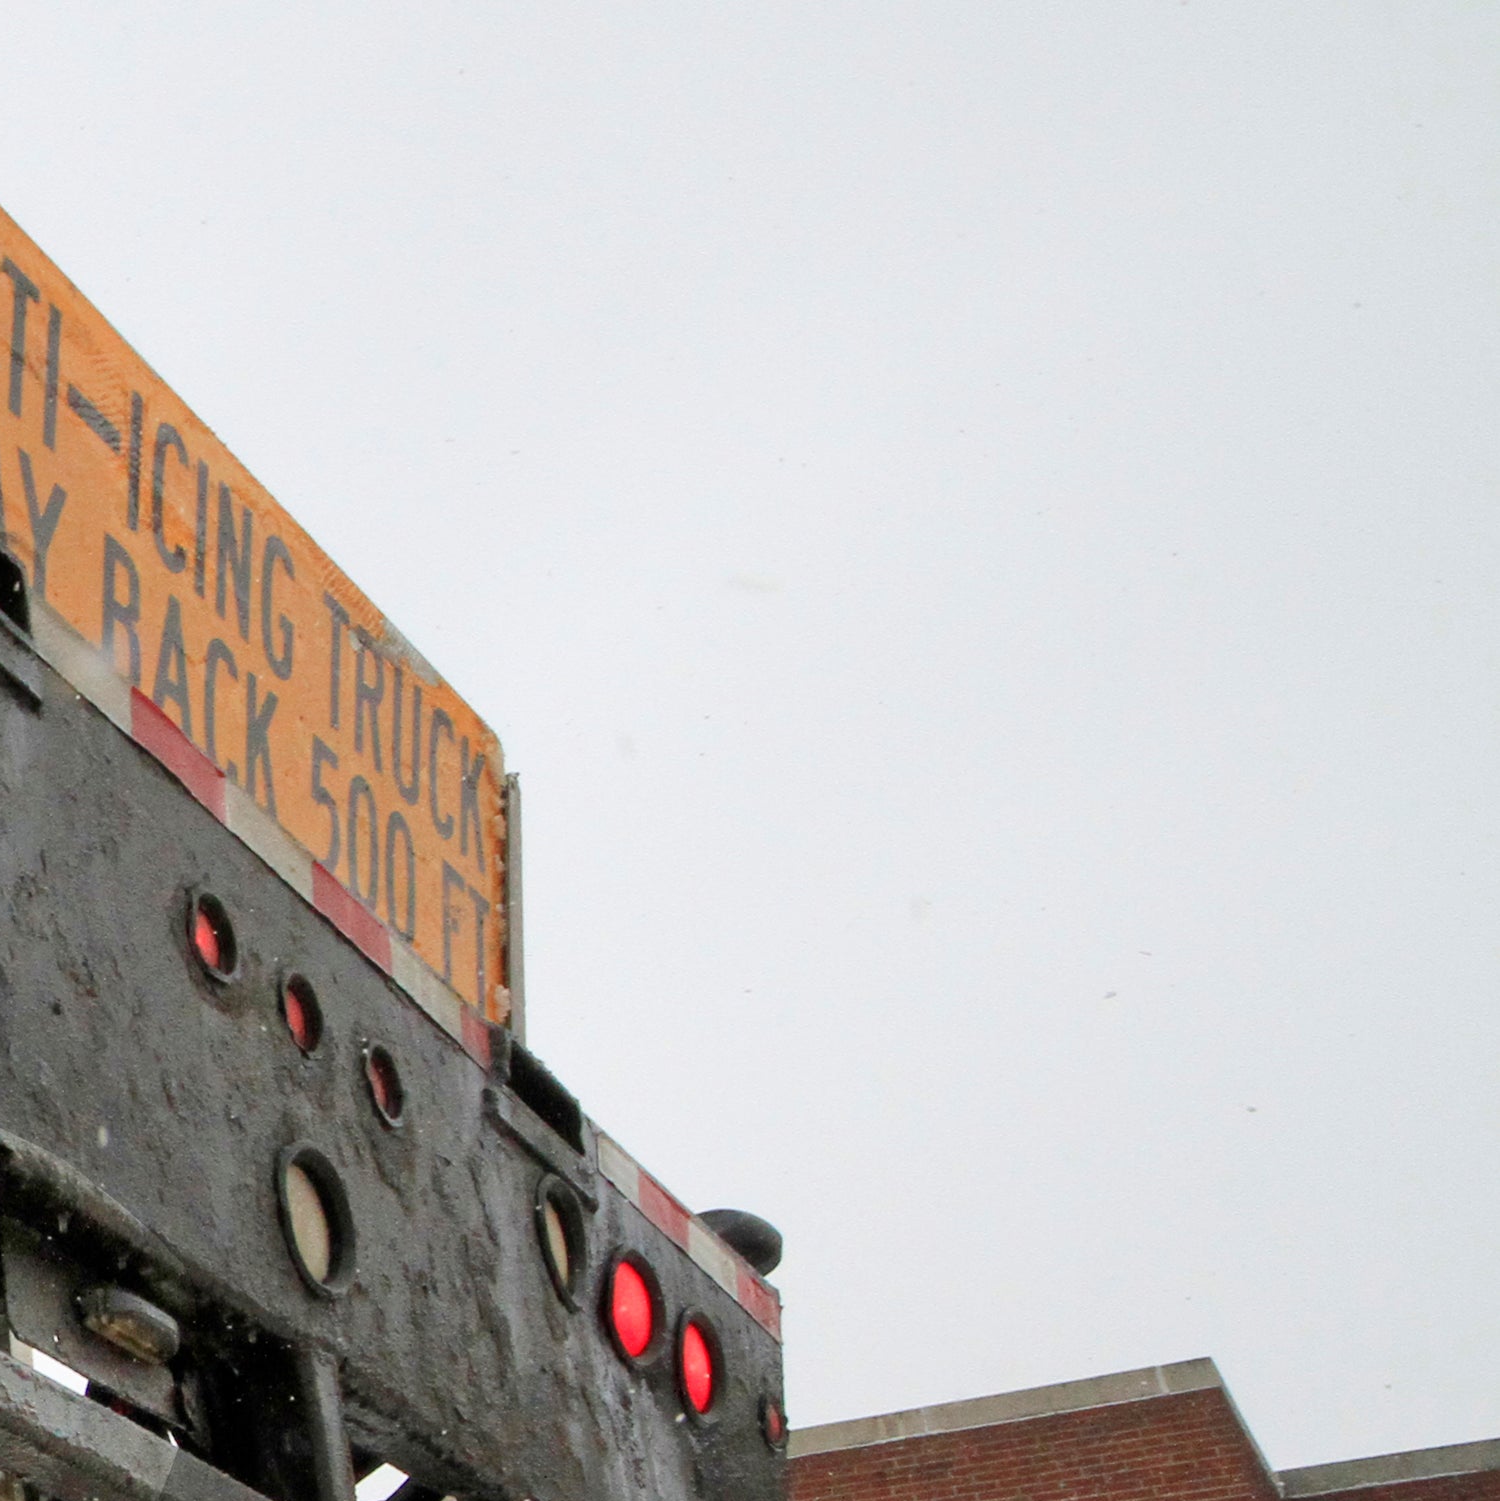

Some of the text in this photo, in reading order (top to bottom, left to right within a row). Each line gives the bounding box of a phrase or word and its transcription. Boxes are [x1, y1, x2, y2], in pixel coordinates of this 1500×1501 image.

[102, 533, 279, 822] BACK
[309, 735, 416, 944] 500
[443, 859, 490, 1018] FT
[322, 588, 488, 873] TRUCK
